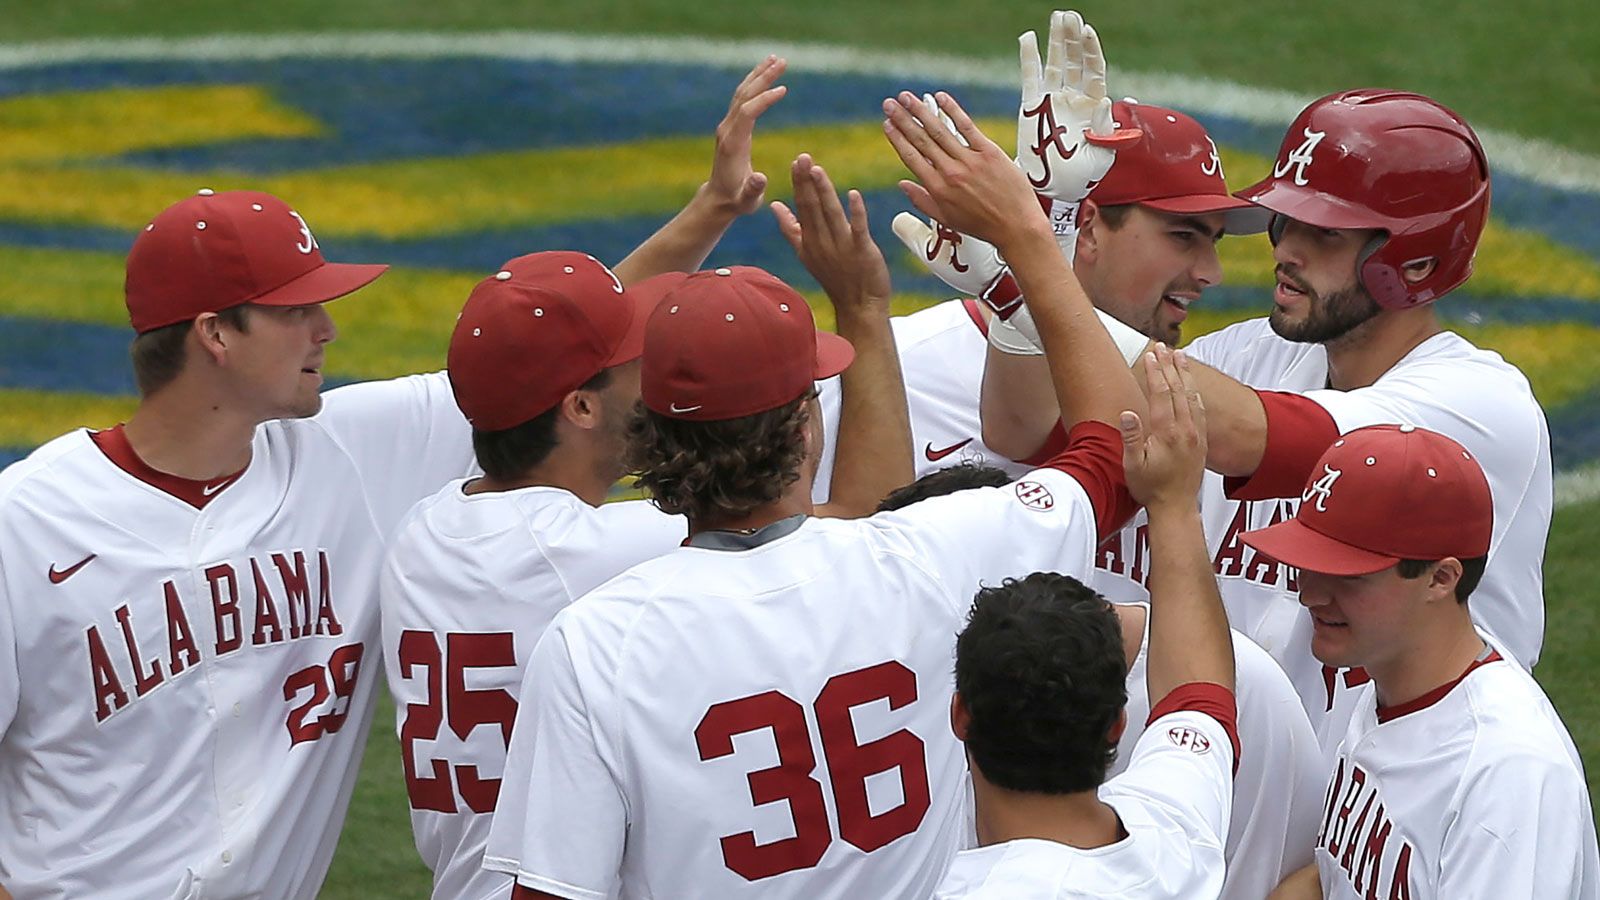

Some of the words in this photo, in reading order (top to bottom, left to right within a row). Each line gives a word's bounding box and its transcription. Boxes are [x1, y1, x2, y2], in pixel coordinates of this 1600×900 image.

[1023, 93, 1078, 189] A
[1274, 127, 1326, 186] A
[1302, 463, 1342, 512] A
[86, 550, 343, 723] ALABAMA
[283, 641, 364, 749] 29
[399, 629, 519, 814] 25
[694, 660, 931, 881] 36
